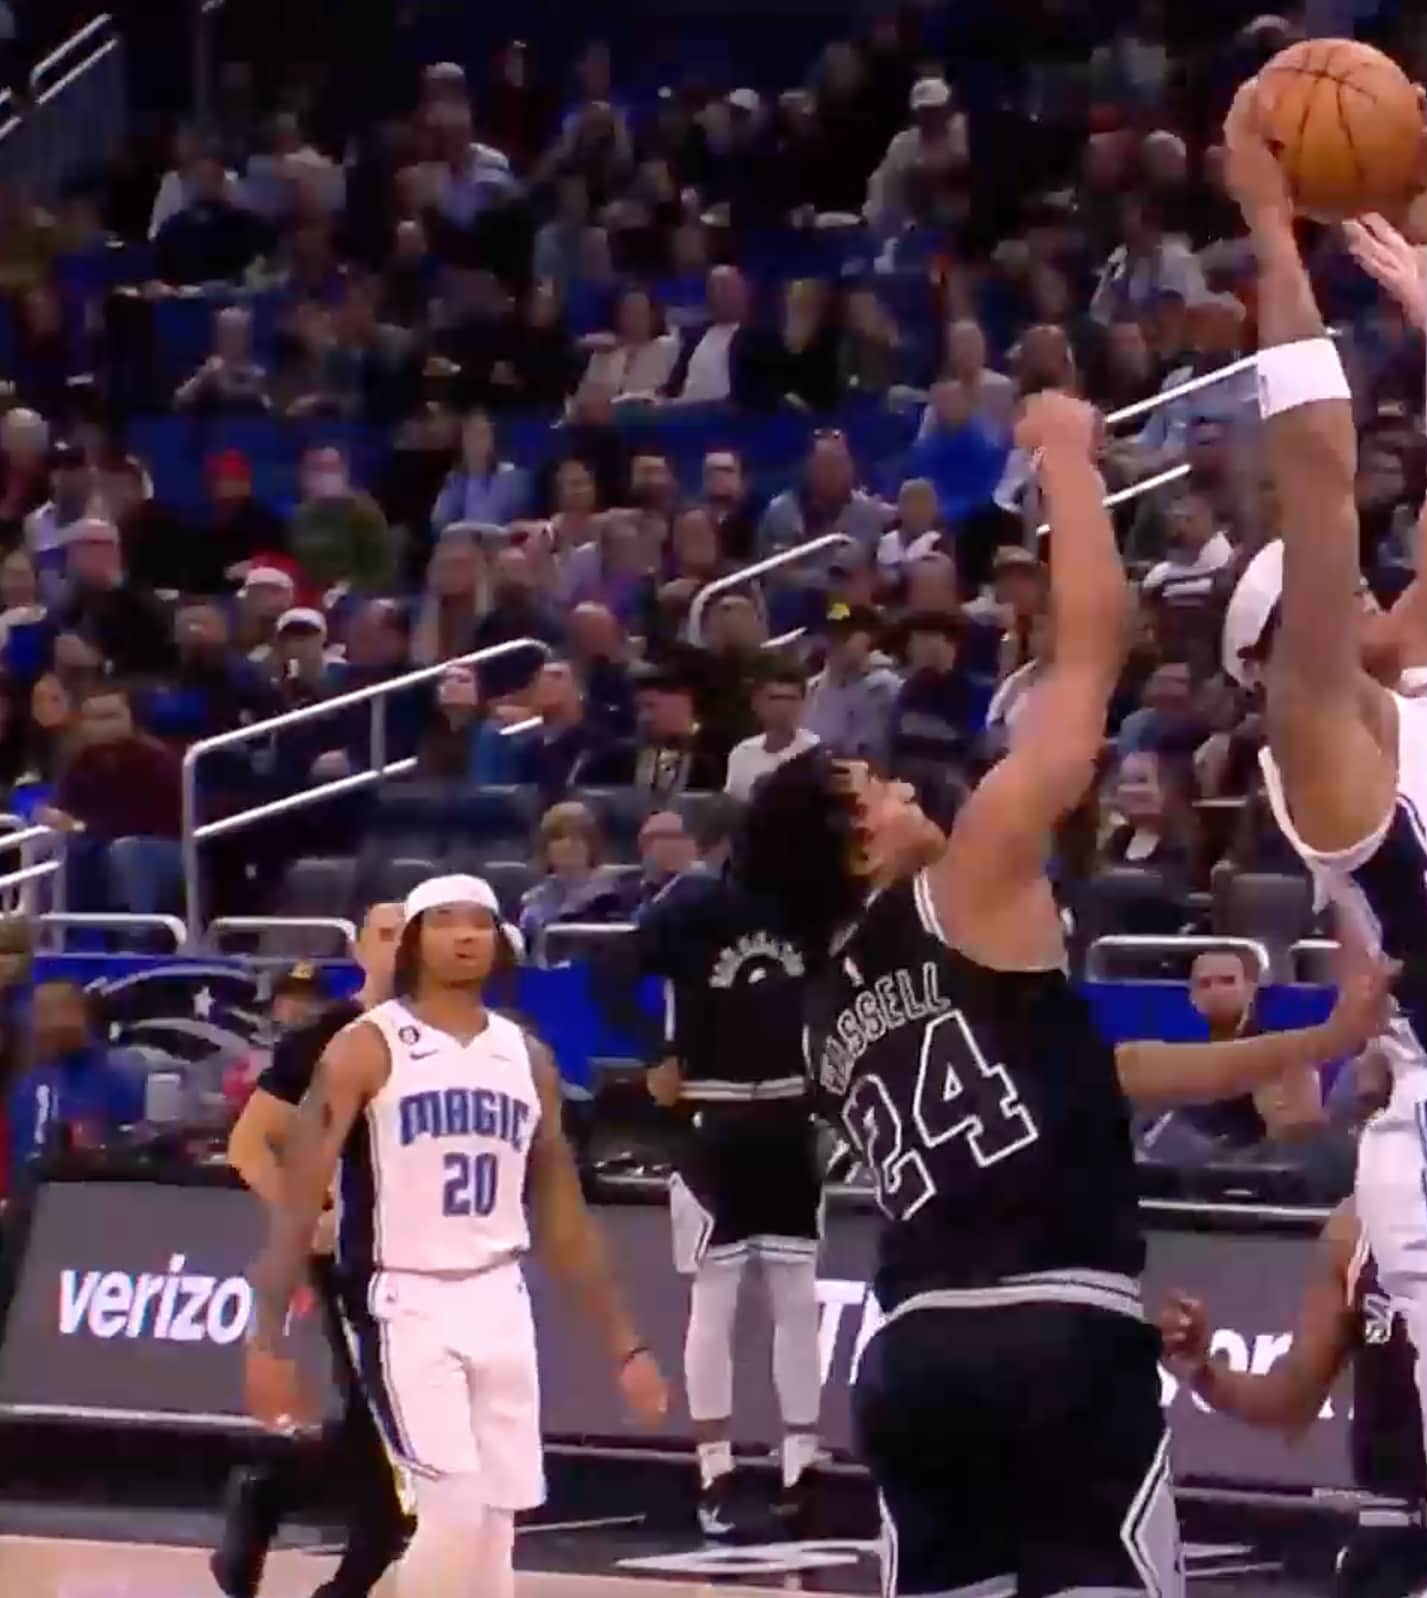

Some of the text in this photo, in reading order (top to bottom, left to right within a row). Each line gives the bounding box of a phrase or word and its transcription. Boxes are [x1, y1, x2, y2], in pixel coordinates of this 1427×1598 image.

[400, 1086, 530, 1153] MAGIC
[843, 1009, 1039, 1221] 24
[443, 1152, 498, 1218] 20
[59, 1253, 292, 1345] verizo
